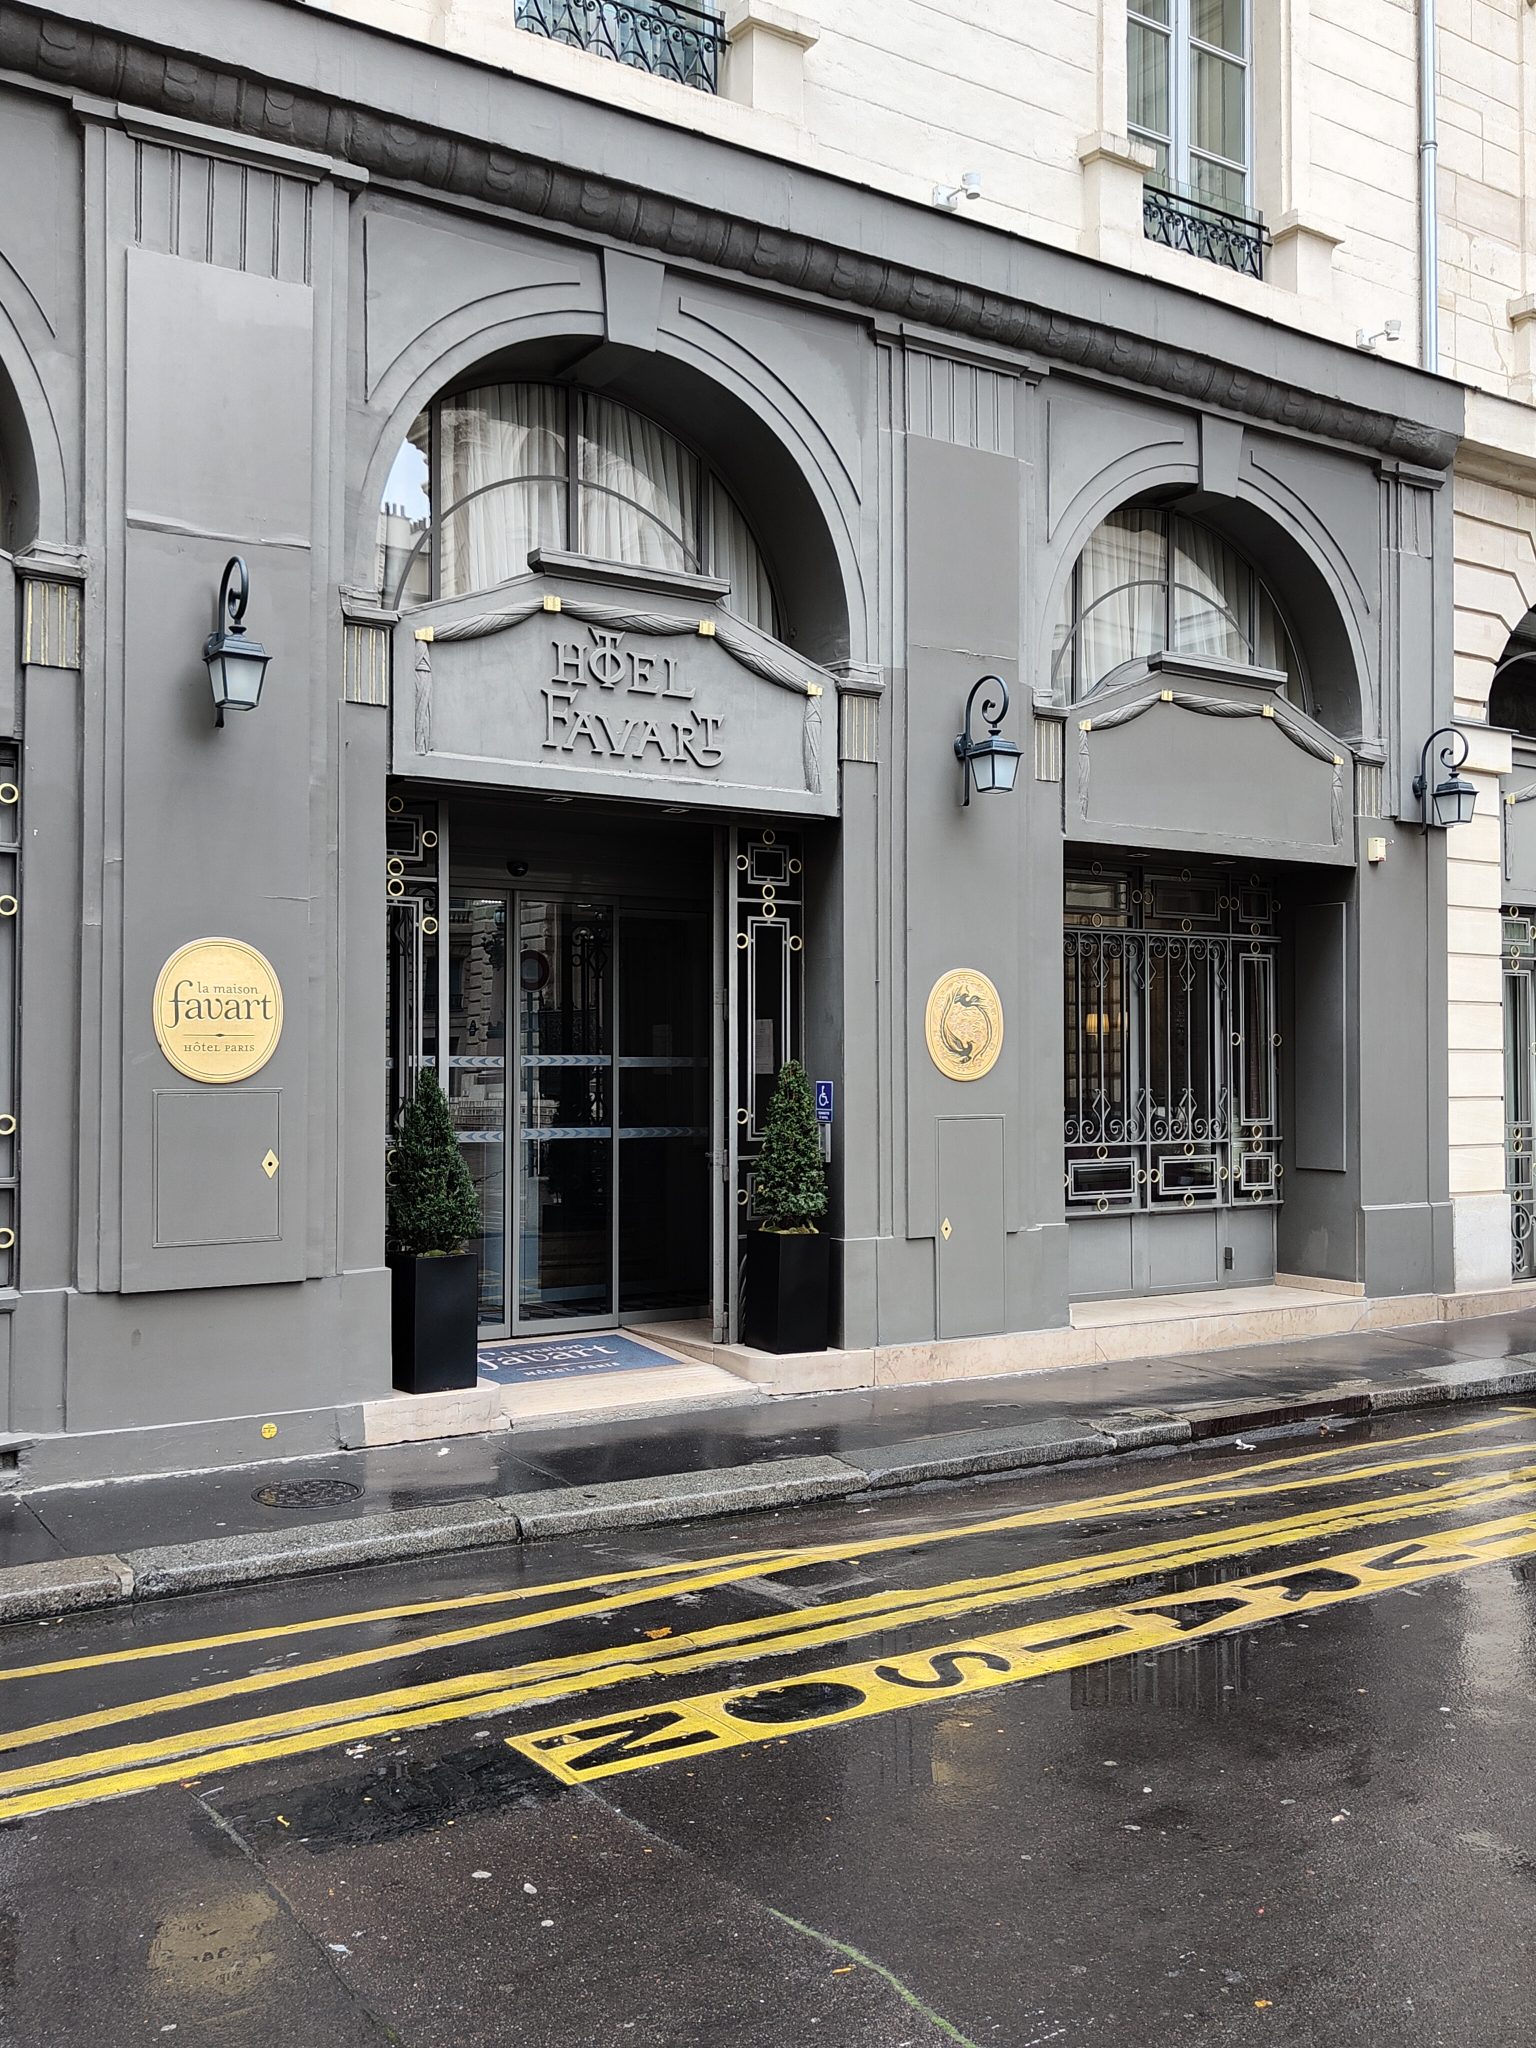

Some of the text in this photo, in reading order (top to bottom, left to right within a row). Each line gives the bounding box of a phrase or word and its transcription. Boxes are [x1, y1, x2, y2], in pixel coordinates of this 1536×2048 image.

[541, 688, 725, 768] FAVART
[164, 979, 274, 1029] favart
[197, 981, 259, 994] la maison
[477, 1344, 618, 1371] favart
[523, 1343, 584, 1354] maison
[533, 1518, 1536, 1772] IVRAISON
